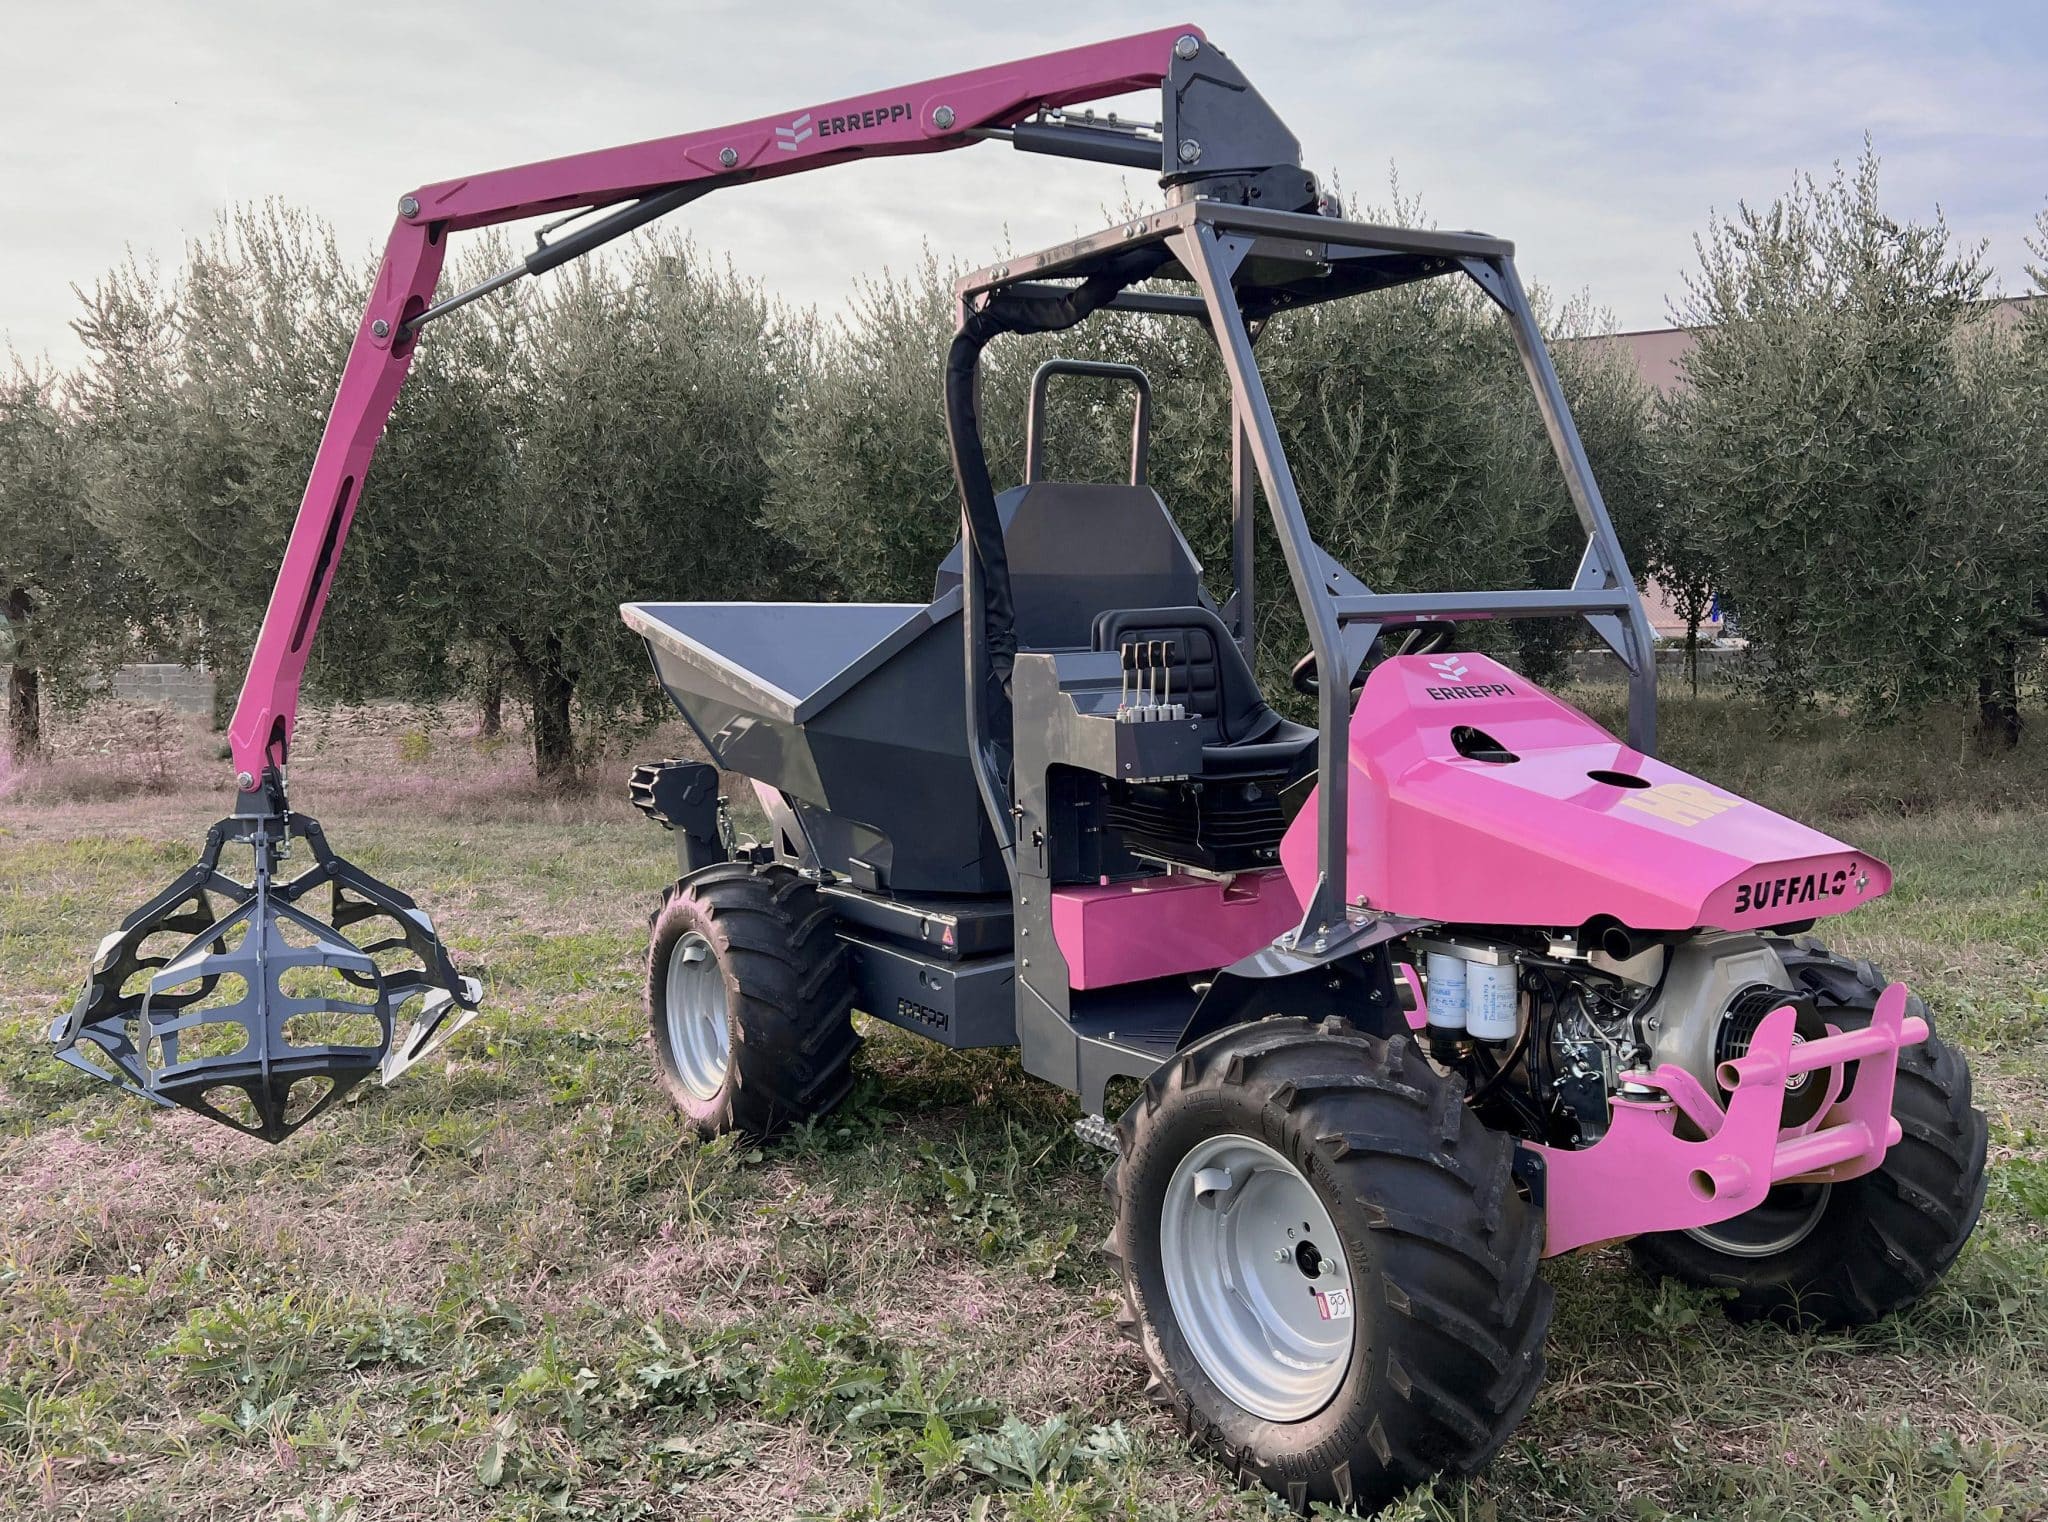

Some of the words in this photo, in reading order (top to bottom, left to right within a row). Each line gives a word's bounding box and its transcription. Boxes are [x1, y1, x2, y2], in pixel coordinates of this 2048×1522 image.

[817, 102, 912, 137] ERREPPI
[1425, 683, 1516, 701] ERREPPI
[897, 997, 949, 1032] ERREPPI
